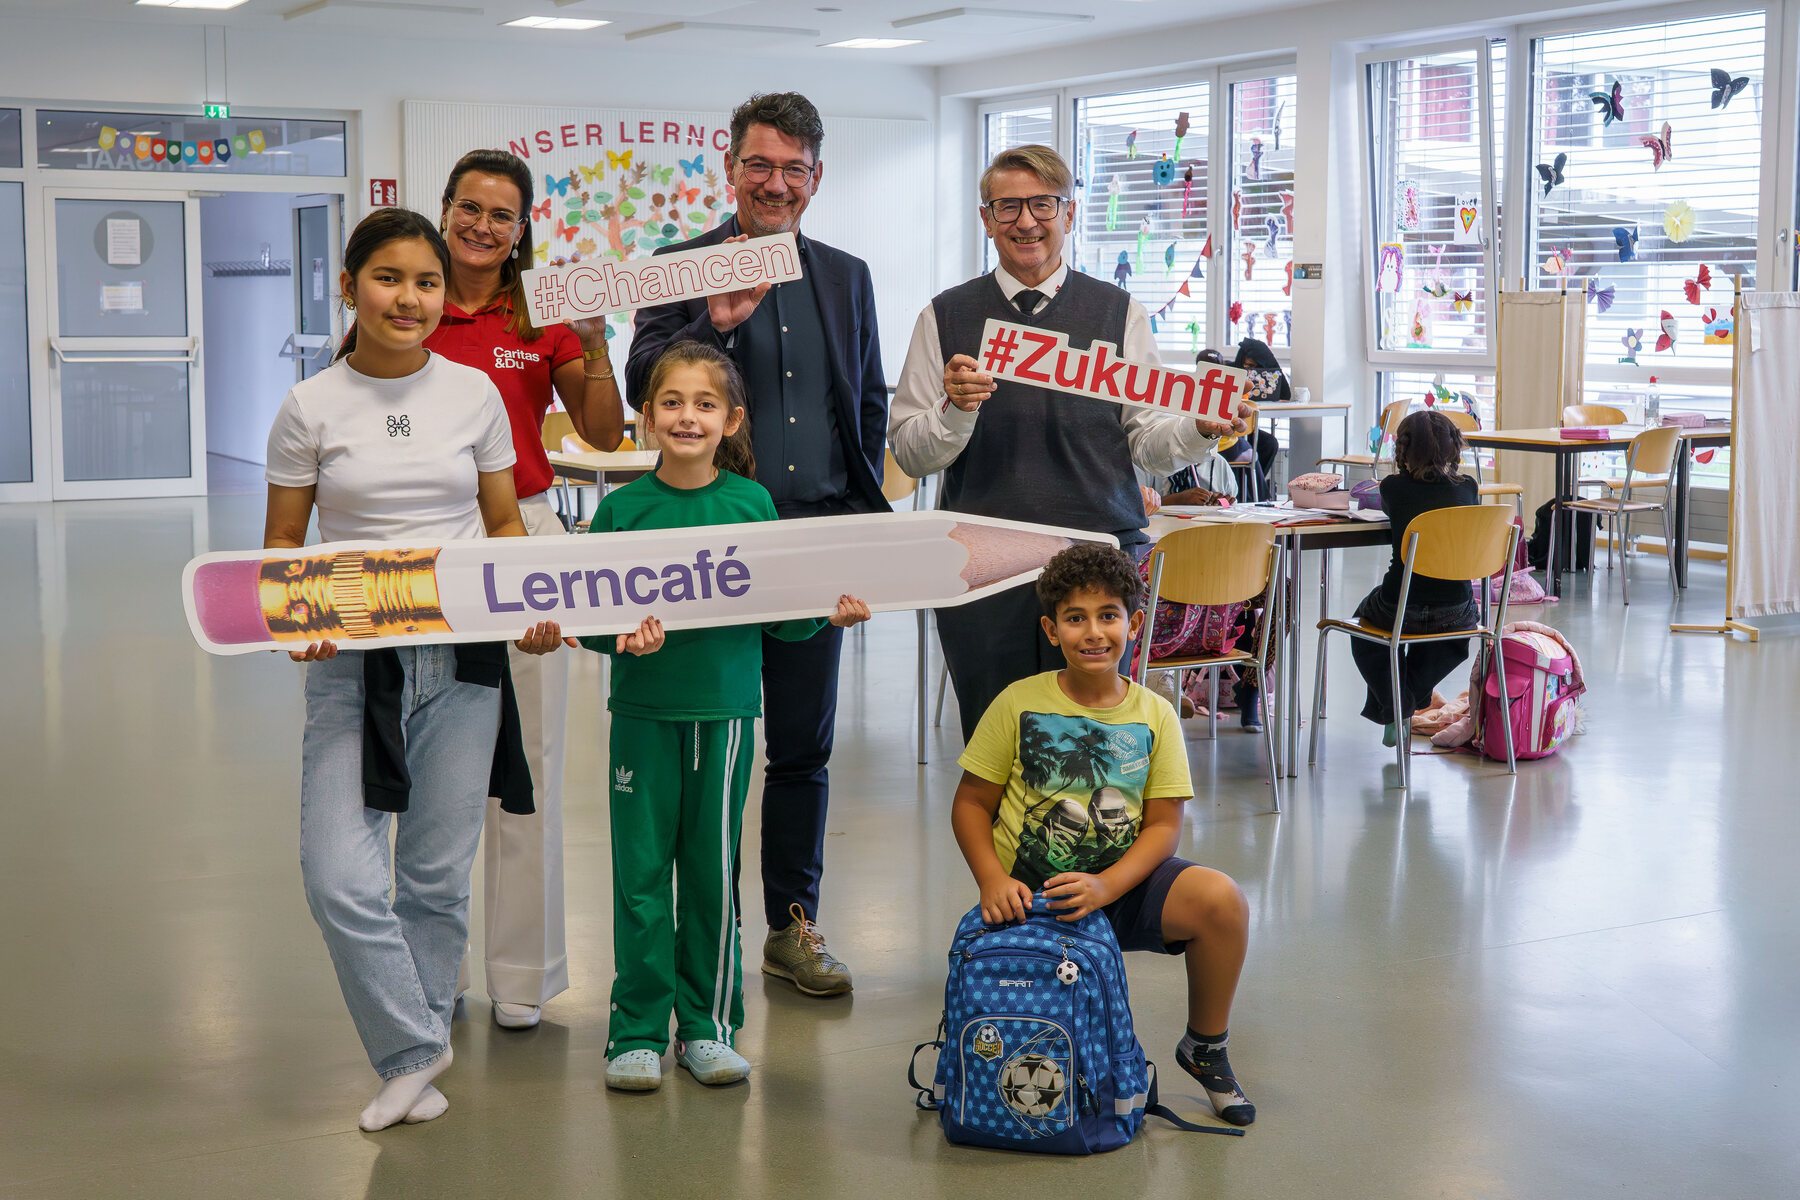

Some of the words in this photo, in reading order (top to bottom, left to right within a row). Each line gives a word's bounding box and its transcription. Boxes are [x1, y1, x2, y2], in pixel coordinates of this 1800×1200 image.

[500, 124, 603, 160] NSER
[619, 121, 730, 151] LERNC
[534, 243, 796, 320] #Chancen
[493, 346, 540, 362] Caritas
[494, 357, 525, 370] &Du
[983, 327, 1239, 420] #Zukunft
[482, 545, 752, 613] Lerncafé
[614, 783, 633, 793] adidas
[998, 979, 1034, 988] SPIRIT
